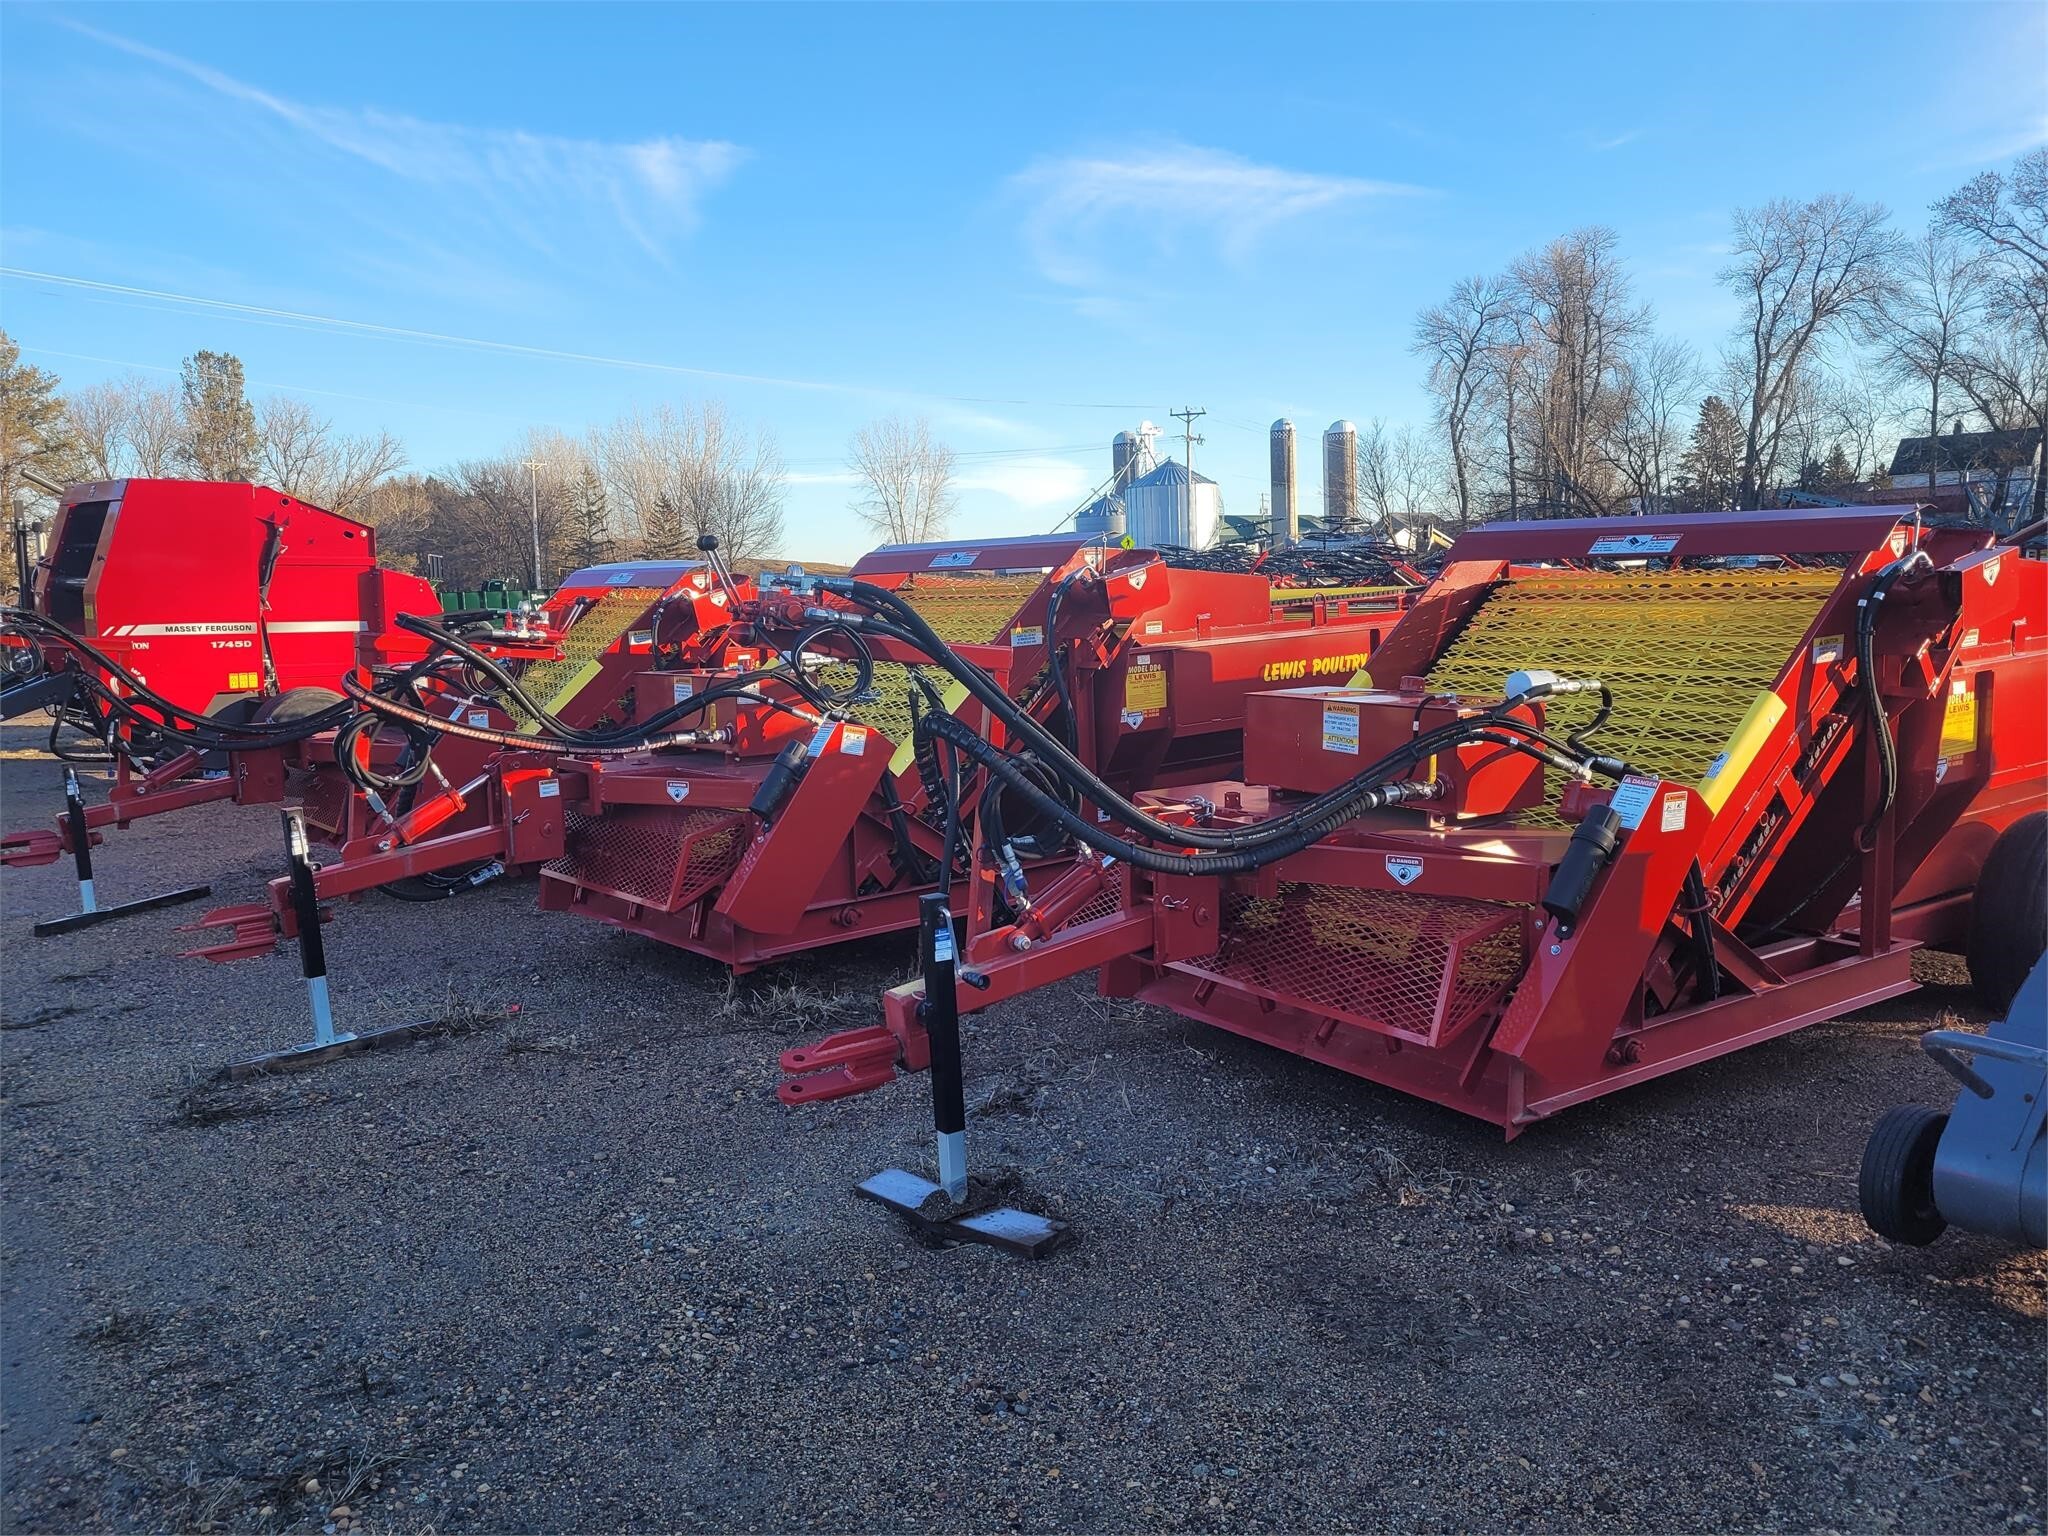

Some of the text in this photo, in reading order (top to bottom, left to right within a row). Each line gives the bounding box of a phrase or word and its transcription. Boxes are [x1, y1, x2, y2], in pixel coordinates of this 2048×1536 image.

[165, 624, 252, 633] MASSEY FERGUSON
[210, 640, 252, 649] 1745D
[1128, 665, 1148, 674] MODEL
[1264, 653, 1368, 682] LEWIS POULTRY
[1134, 672, 1157, 681] LEWIS
[1332, 705, 1356, 713] WARNING
[1948, 703, 1970, 714] LEWIS
[1631, 779, 1658, 788] DANGER
